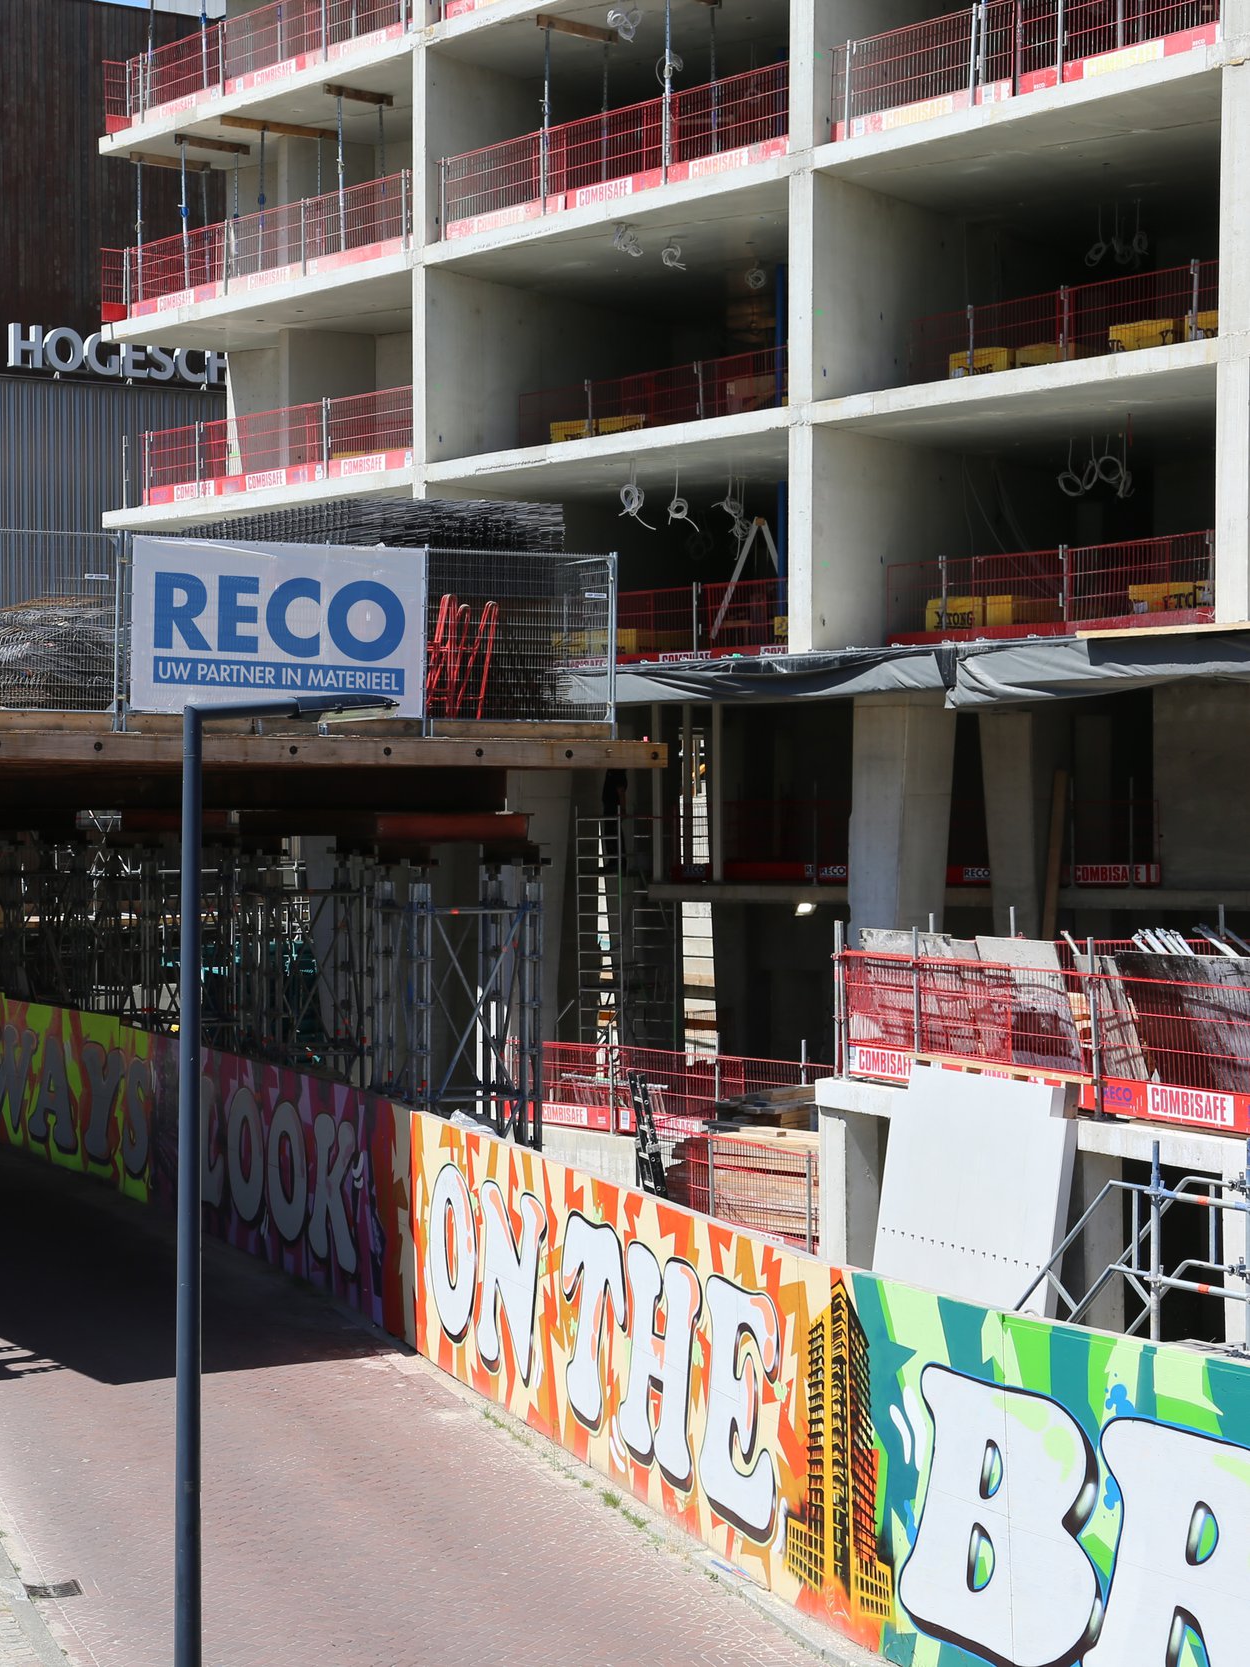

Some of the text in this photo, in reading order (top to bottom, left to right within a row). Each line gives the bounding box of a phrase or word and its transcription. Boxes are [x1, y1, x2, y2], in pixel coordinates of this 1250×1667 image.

[256, 62, 294, 87] COMBISAFE
[161, 96, 195, 118] COMBISAFE
[692, 151, 744, 178] COMBISAFE
[578, 180, 629, 207] COMBISAFE
[159, 290, 192, 312] COMBISAFE
[343, 457, 383, 476] COMBISAFE
[175, 481, 212, 499] COMBIAFE
[247, 471, 284, 490] COMBISAFE
[153, 571, 406, 662] RECO
[158, 661, 400, 691] UW PARTNER IN MATERIEEL
[965, 867, 990, 878] RECO
[1074, 865, 1141, 883] COMBISAE
[1103, 1085, 1133, 1102] RECO
[1151, 1086, 1227, 1123] COMBISAFE
[542, 1105, 584, 1123] COMBISAFE
[430, 1161, 548, 1389] ON
[560, 1208, 781, 1546] THE
